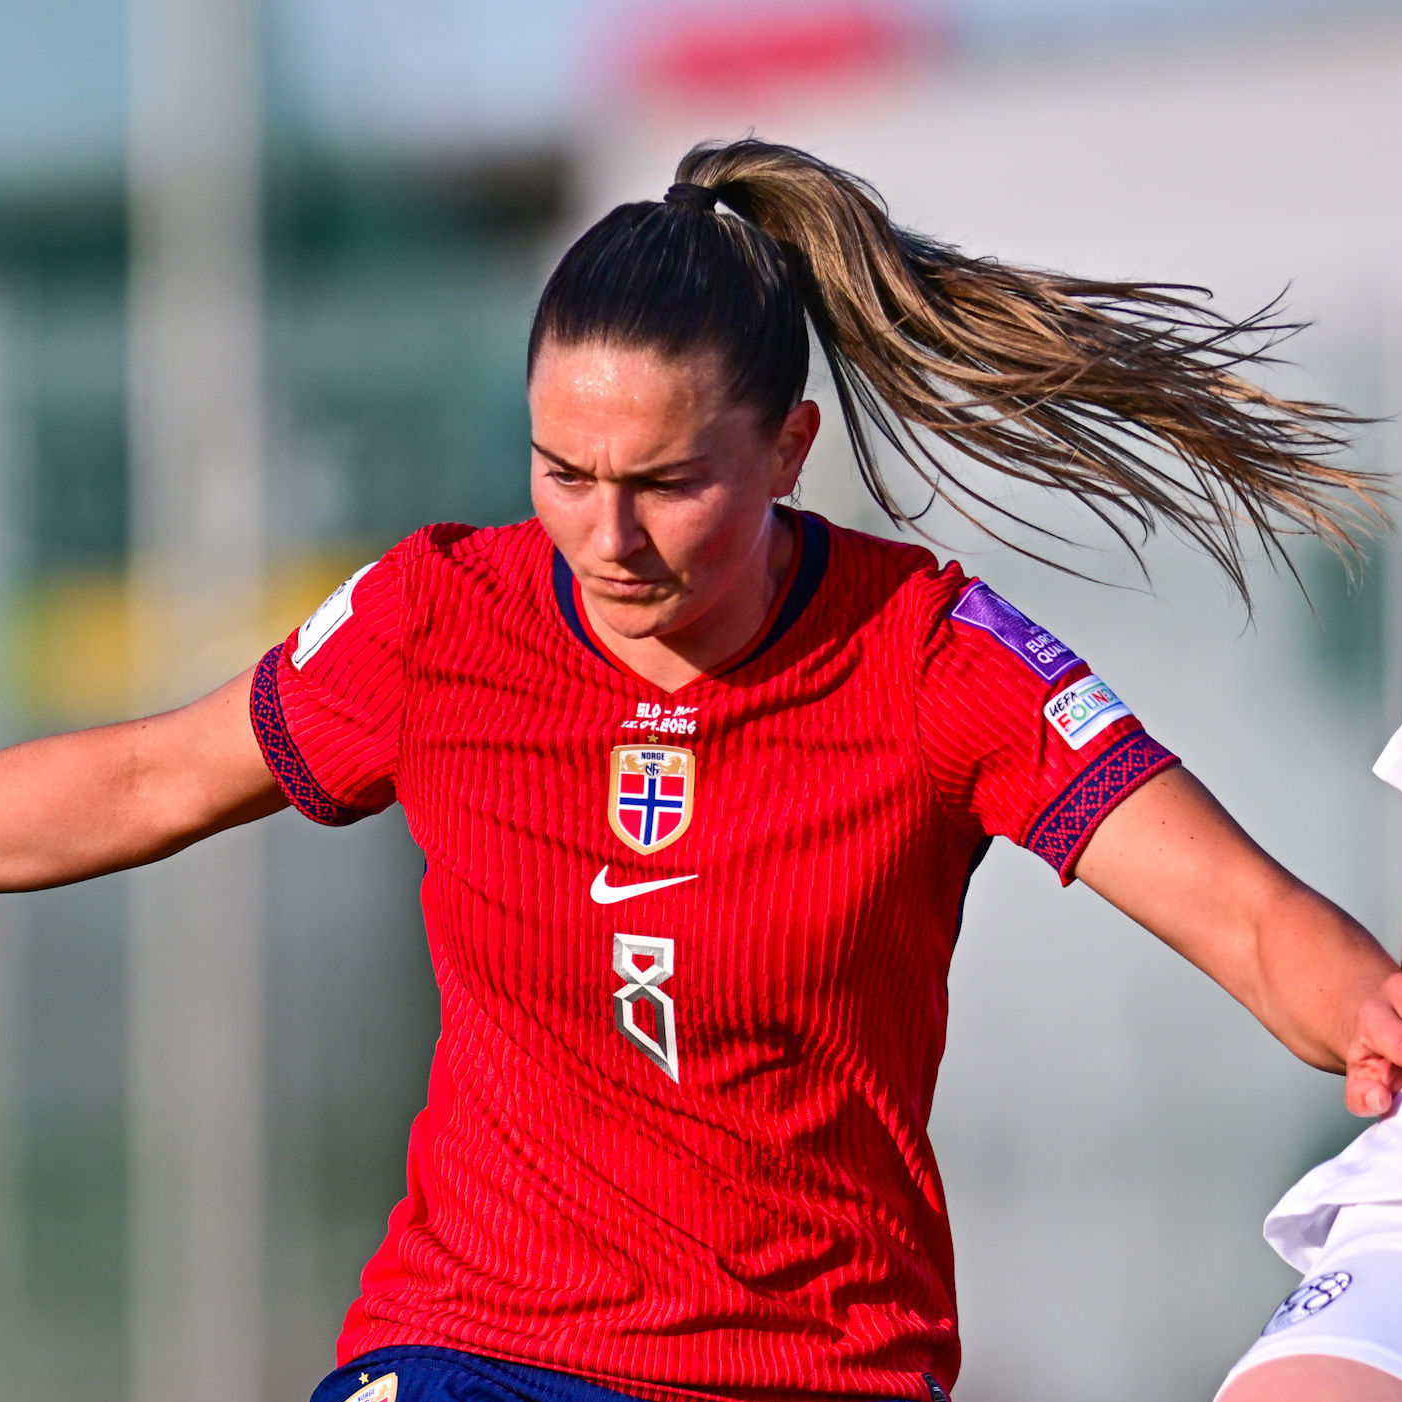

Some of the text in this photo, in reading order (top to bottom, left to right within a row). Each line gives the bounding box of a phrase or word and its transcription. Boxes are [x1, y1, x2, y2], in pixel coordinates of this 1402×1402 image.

[635, 702, 662, 718] SLO
[1049, 691, 1078, 717] UEFA
[641, 751, 665, 761] NORGE
[612, 933, 679, 1085] 8
